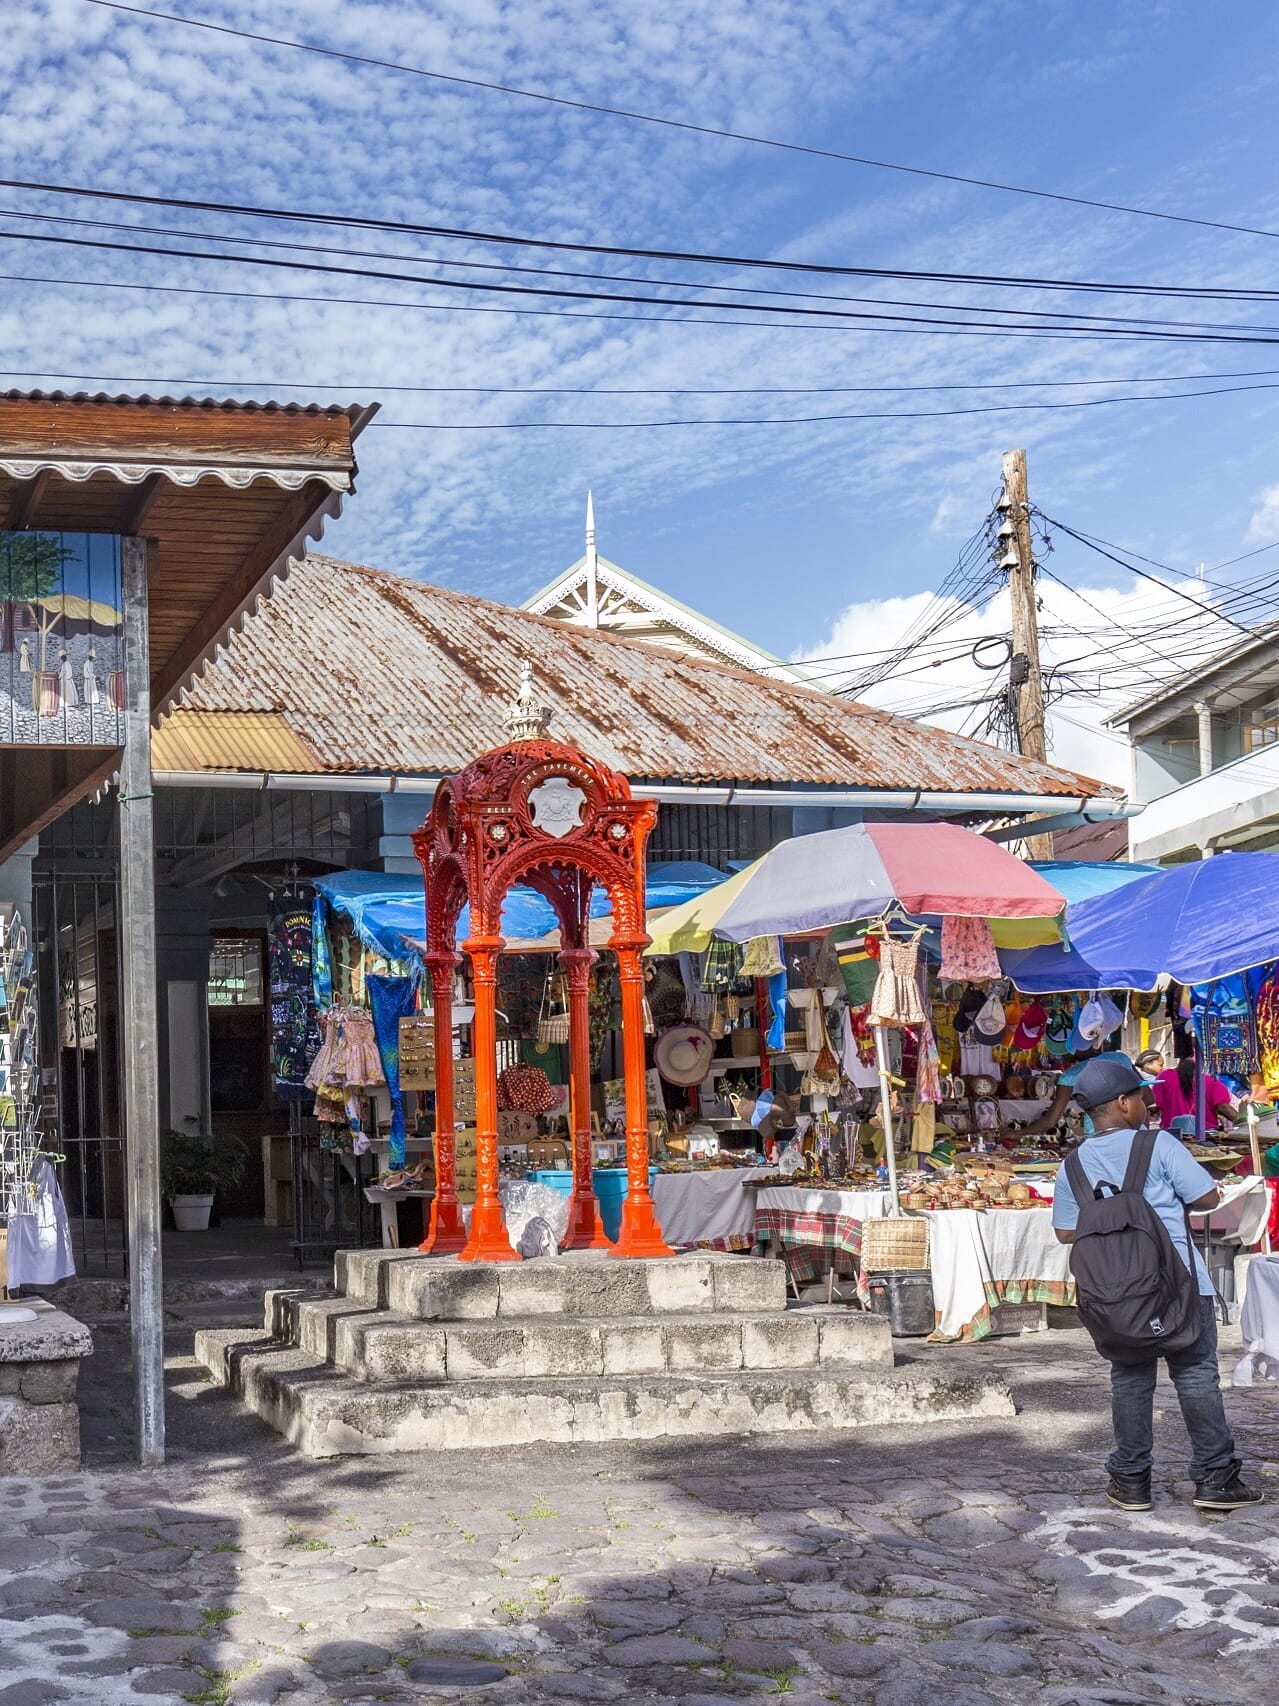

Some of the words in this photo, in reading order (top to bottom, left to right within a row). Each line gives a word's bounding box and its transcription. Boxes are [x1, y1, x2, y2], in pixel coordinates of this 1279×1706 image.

[521, 770, 537, 784] THE
[543, 763, 594, 784] PAVEMENT
[285, 916, 311, 928] DOMINIC
